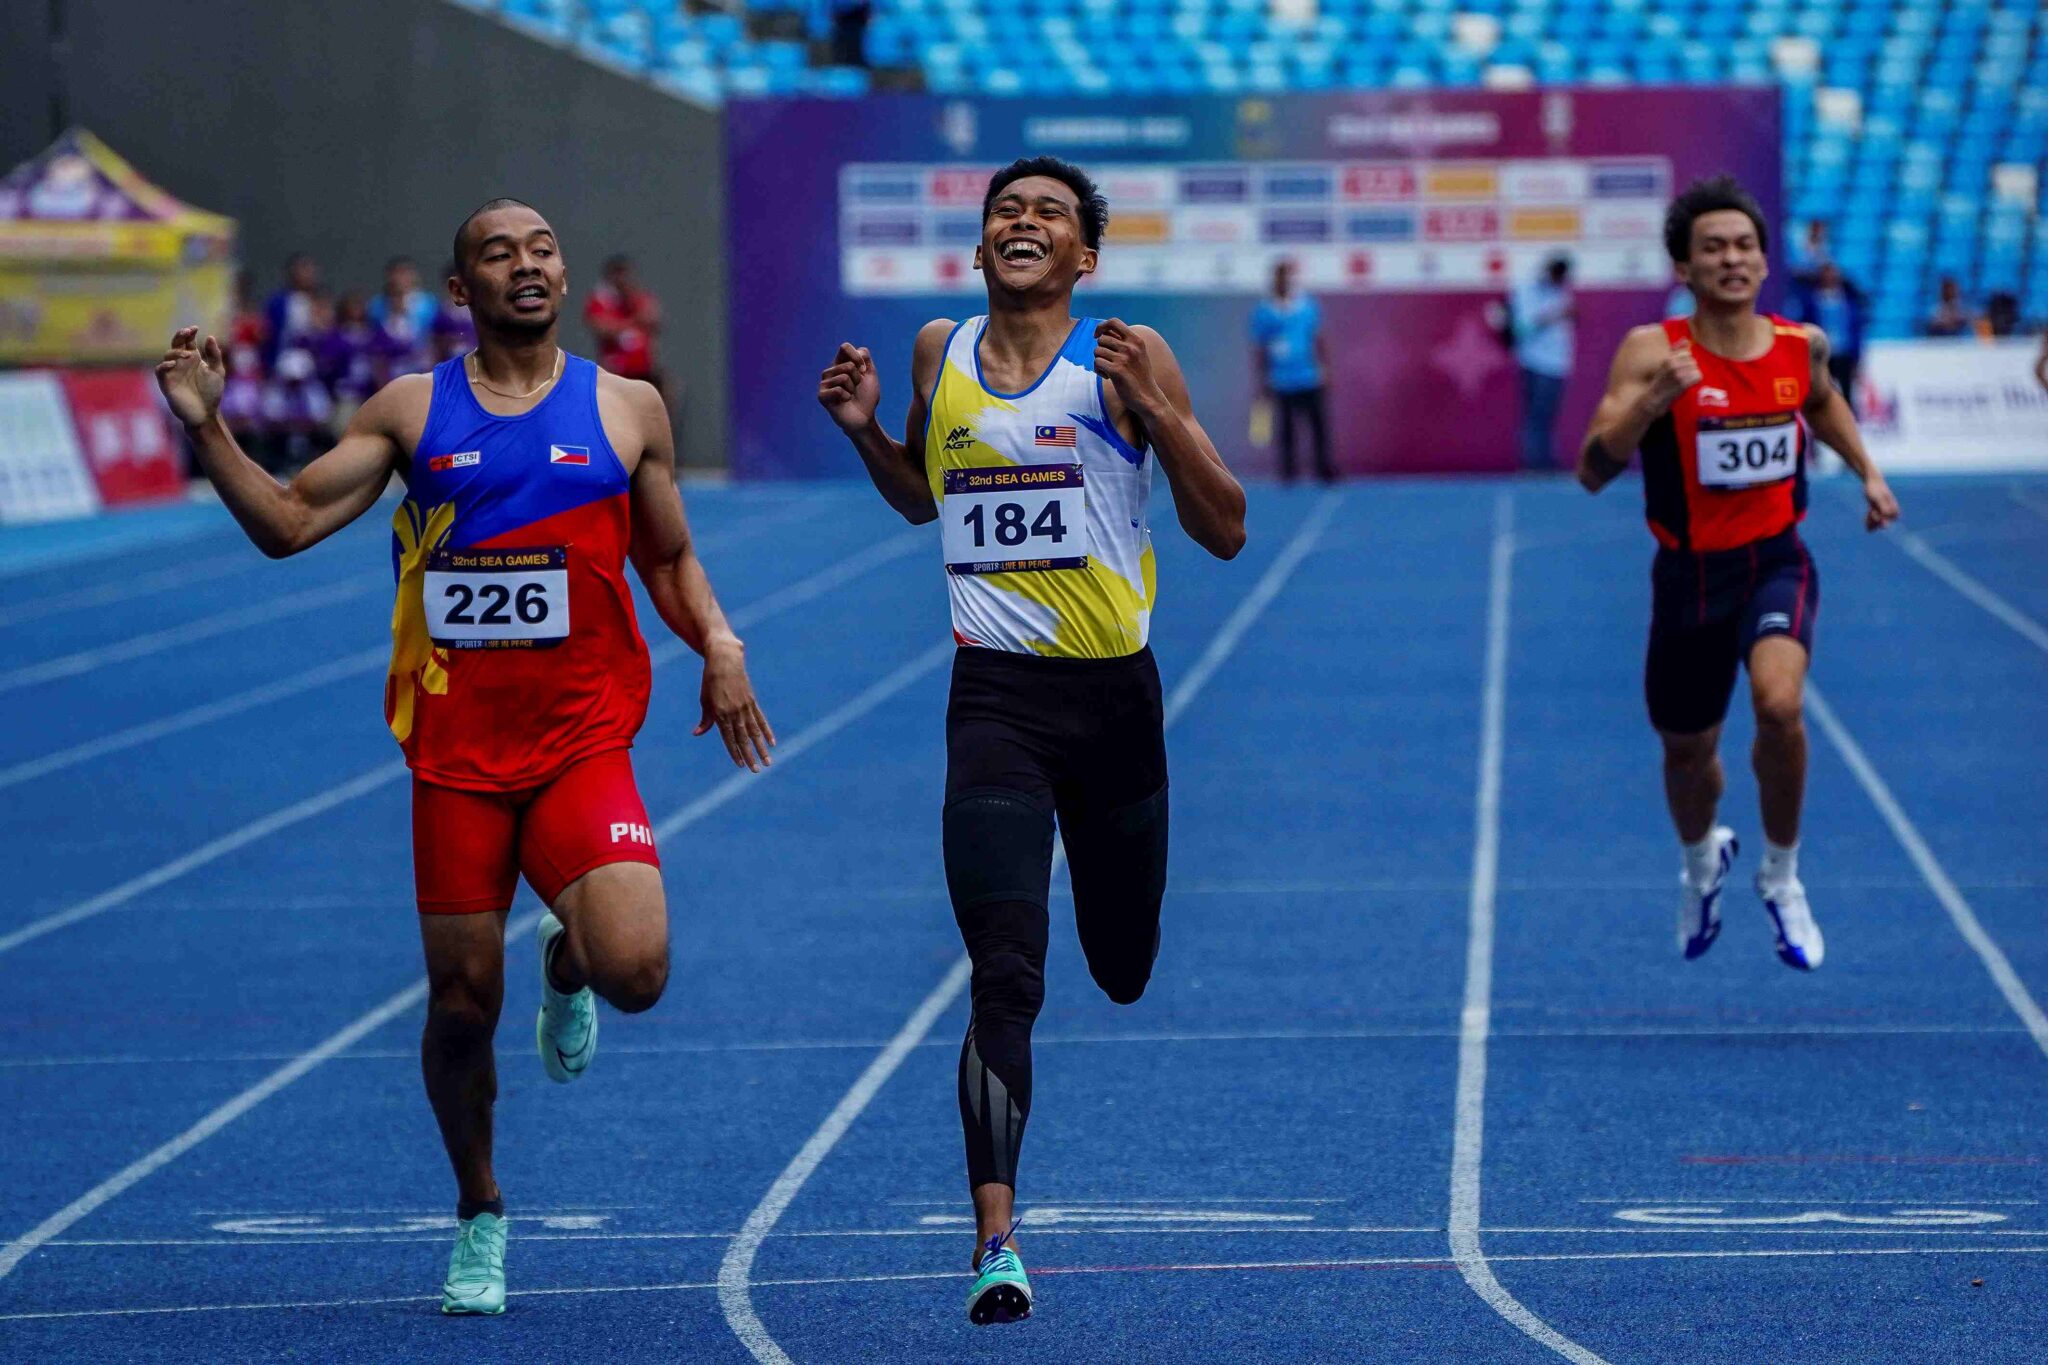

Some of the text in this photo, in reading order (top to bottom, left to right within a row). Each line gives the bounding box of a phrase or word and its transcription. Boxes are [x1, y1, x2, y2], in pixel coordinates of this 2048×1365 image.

[943, 440, 975, 451] AGT
[454, 453, 477, 463] ICTSI
[1718, 436, 1787, 472] 304
[969, 471, 1066, 486] 32nd SEA GAMES
[964, 500, 1067, 547] 184
[452, 554, 549, 566] 32nd SEA GAMES
[1028, 560, 1051, 568] PEACE
[444, 583, 549, 625] 226
[511, 639, 533, 647] PEACE
[610, 823, 653, 847] PHI
